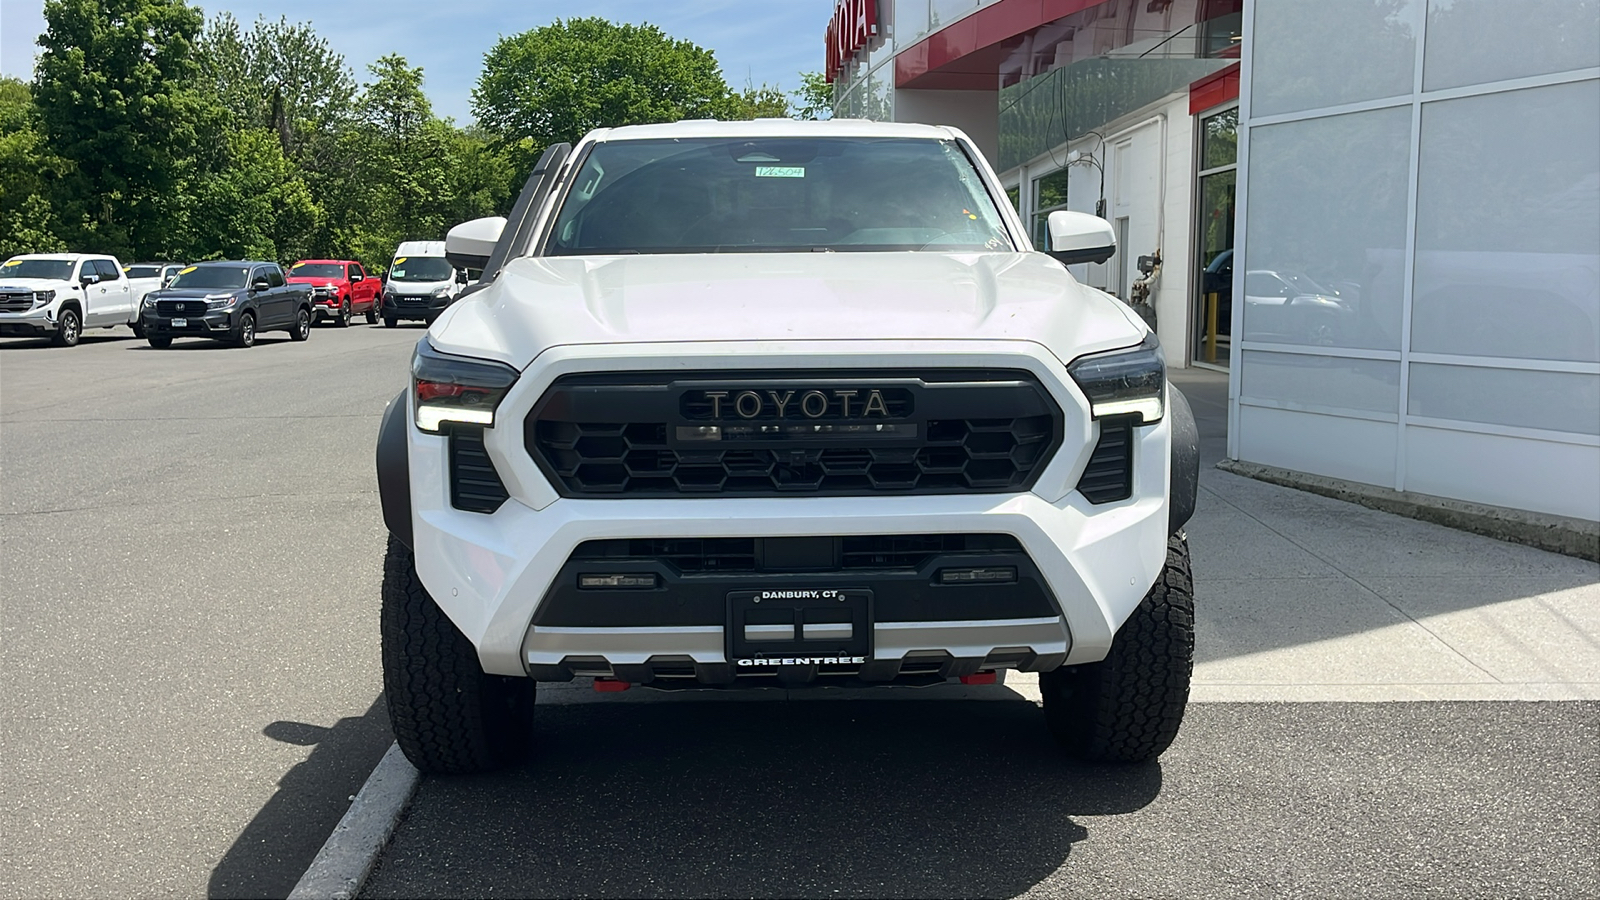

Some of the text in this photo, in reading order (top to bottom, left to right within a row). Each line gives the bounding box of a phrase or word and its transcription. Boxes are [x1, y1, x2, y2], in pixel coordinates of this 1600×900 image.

[705, 390, 888, 418] TOYOTA
[762, 590, 838, 599] DANBURY, CT
[737, 656, 865, 666] GREENTREE
